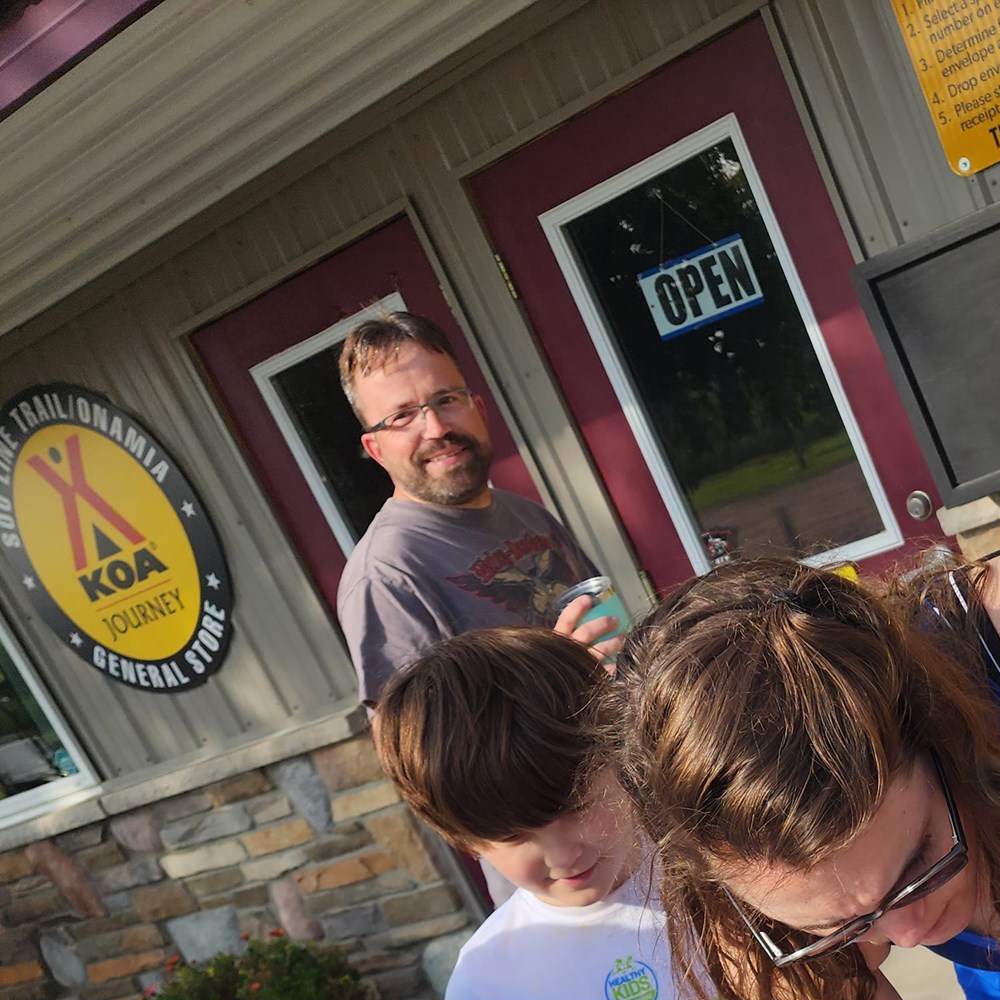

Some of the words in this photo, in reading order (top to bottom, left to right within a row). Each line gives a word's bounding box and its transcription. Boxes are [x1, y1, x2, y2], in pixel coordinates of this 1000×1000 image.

[907, 23, 920, 37] 2.
[924, 2, 960, 28] Select
[930, 12, 974, 43] number
[976, 4, 992, 18] on
[919, 58, 933, 72] 3.
[936, 25, 997, 64] Determine
[942, 42, 995, 78] envelope
[932, 92, 944, 105] 4.
[948, 76, 978, 98] Drop
[939, 111, 951, 126] 5.
[955, 93, 992, 117] Please
[654, 245, 756, 326] OPEN
[9, 393, 170, 484] TRAIL/ONAMIA
[78, 548, 168, 603] KOA
[101, 588, 184, 641] JOURNEY
[93, 645, 190, 689] GENERAL
[184, 599, 226, 675] STORE
[608, 967, 646, 988] HEALTHY
